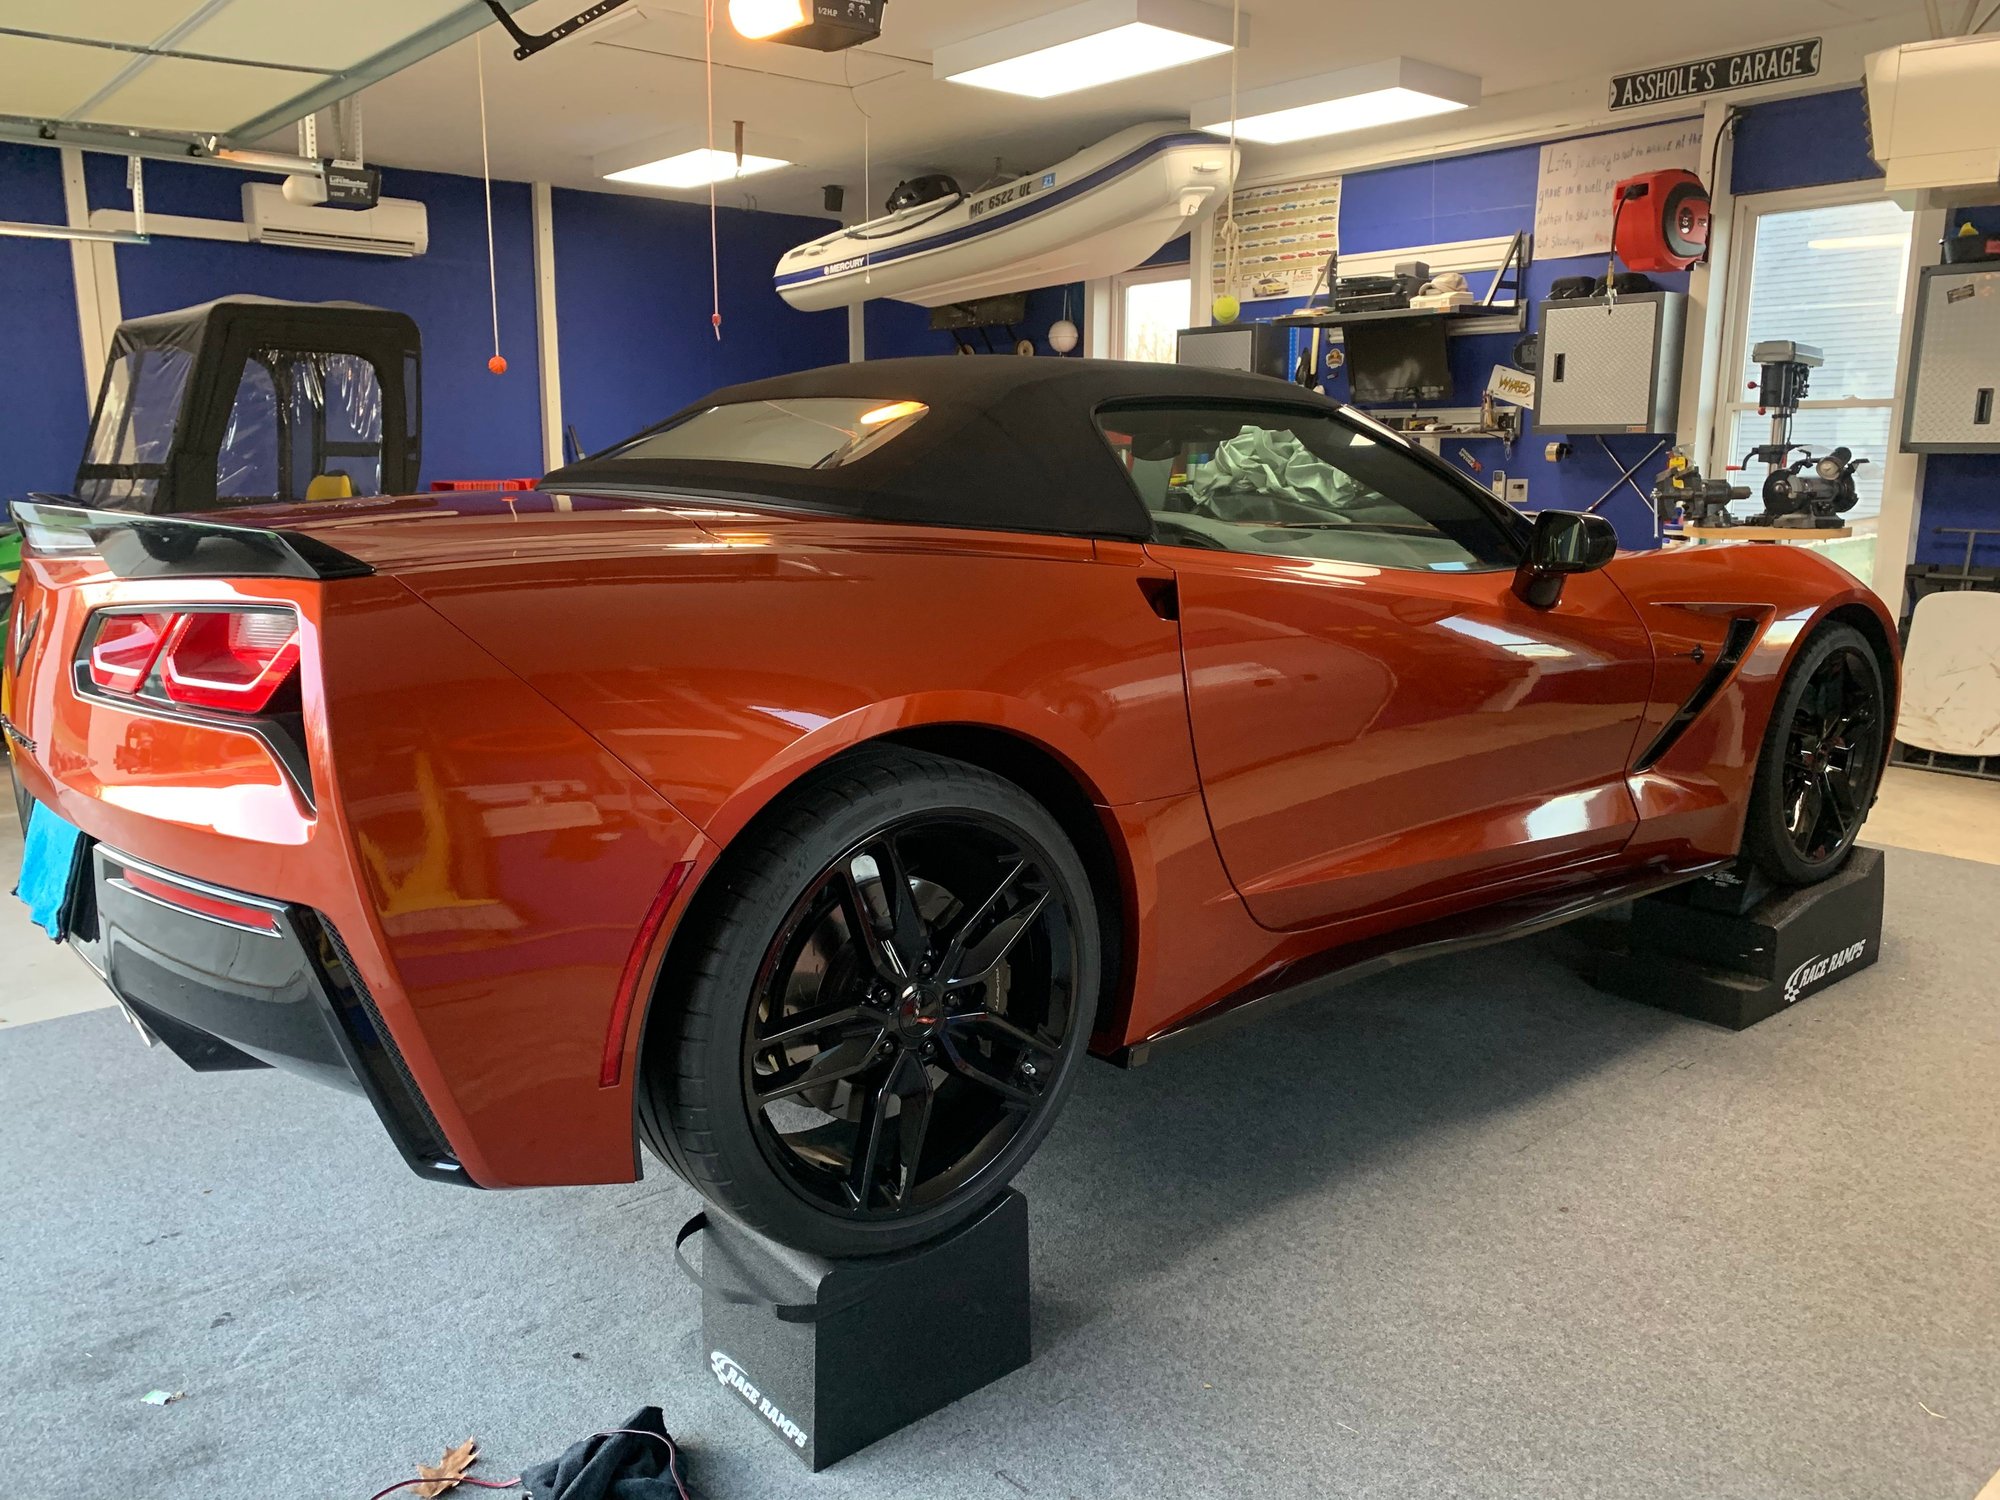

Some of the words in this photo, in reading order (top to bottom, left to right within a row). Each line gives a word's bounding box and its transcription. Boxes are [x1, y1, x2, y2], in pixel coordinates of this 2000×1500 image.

[1621, 62, 1716, 105] ASSHOLE'S
[1729, 45, 1804, 85] GARAGE
[969, 200, 984, 220] MC
[988, 188, 1014, 210] 6522
[1019, 181, 1032, 198] UE
[829, 257, 865, 274] MERCURY
[1799, 957, 1830, 989] RACE
[1827, 938, 1867, 974] RAMPS
[726, 1366, 761, 1406] RACE
[759, 1397, 808, 1449] RAMPS
